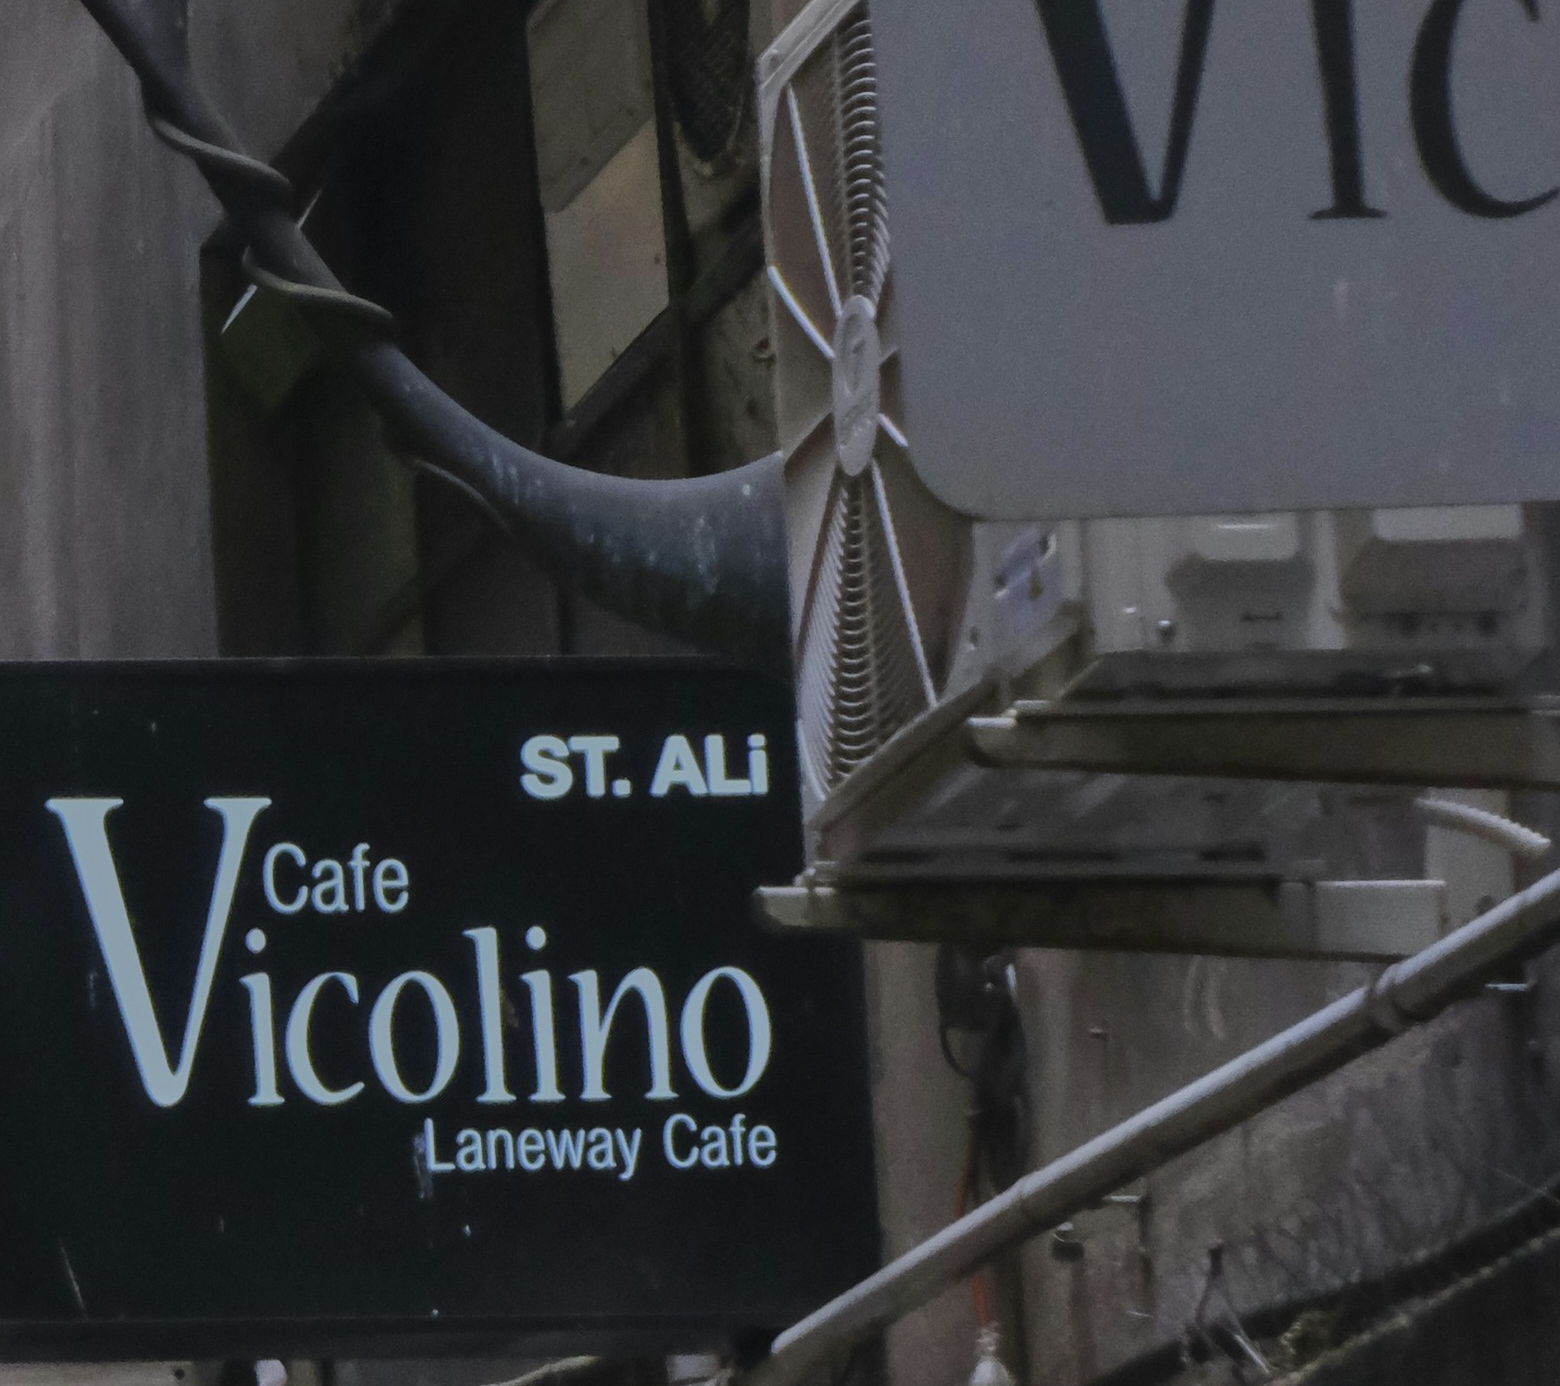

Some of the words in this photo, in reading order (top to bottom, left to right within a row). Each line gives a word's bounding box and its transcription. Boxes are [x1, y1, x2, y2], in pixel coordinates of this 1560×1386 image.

[521, 735, 630, 799] ST.
[262, 842, 410, 915] Cafe
[45, 797, 773, 1107] Vicolino
[423, 1117, 642, 1180] Laneway
[663, 1113, 777, 1170] Cafe
